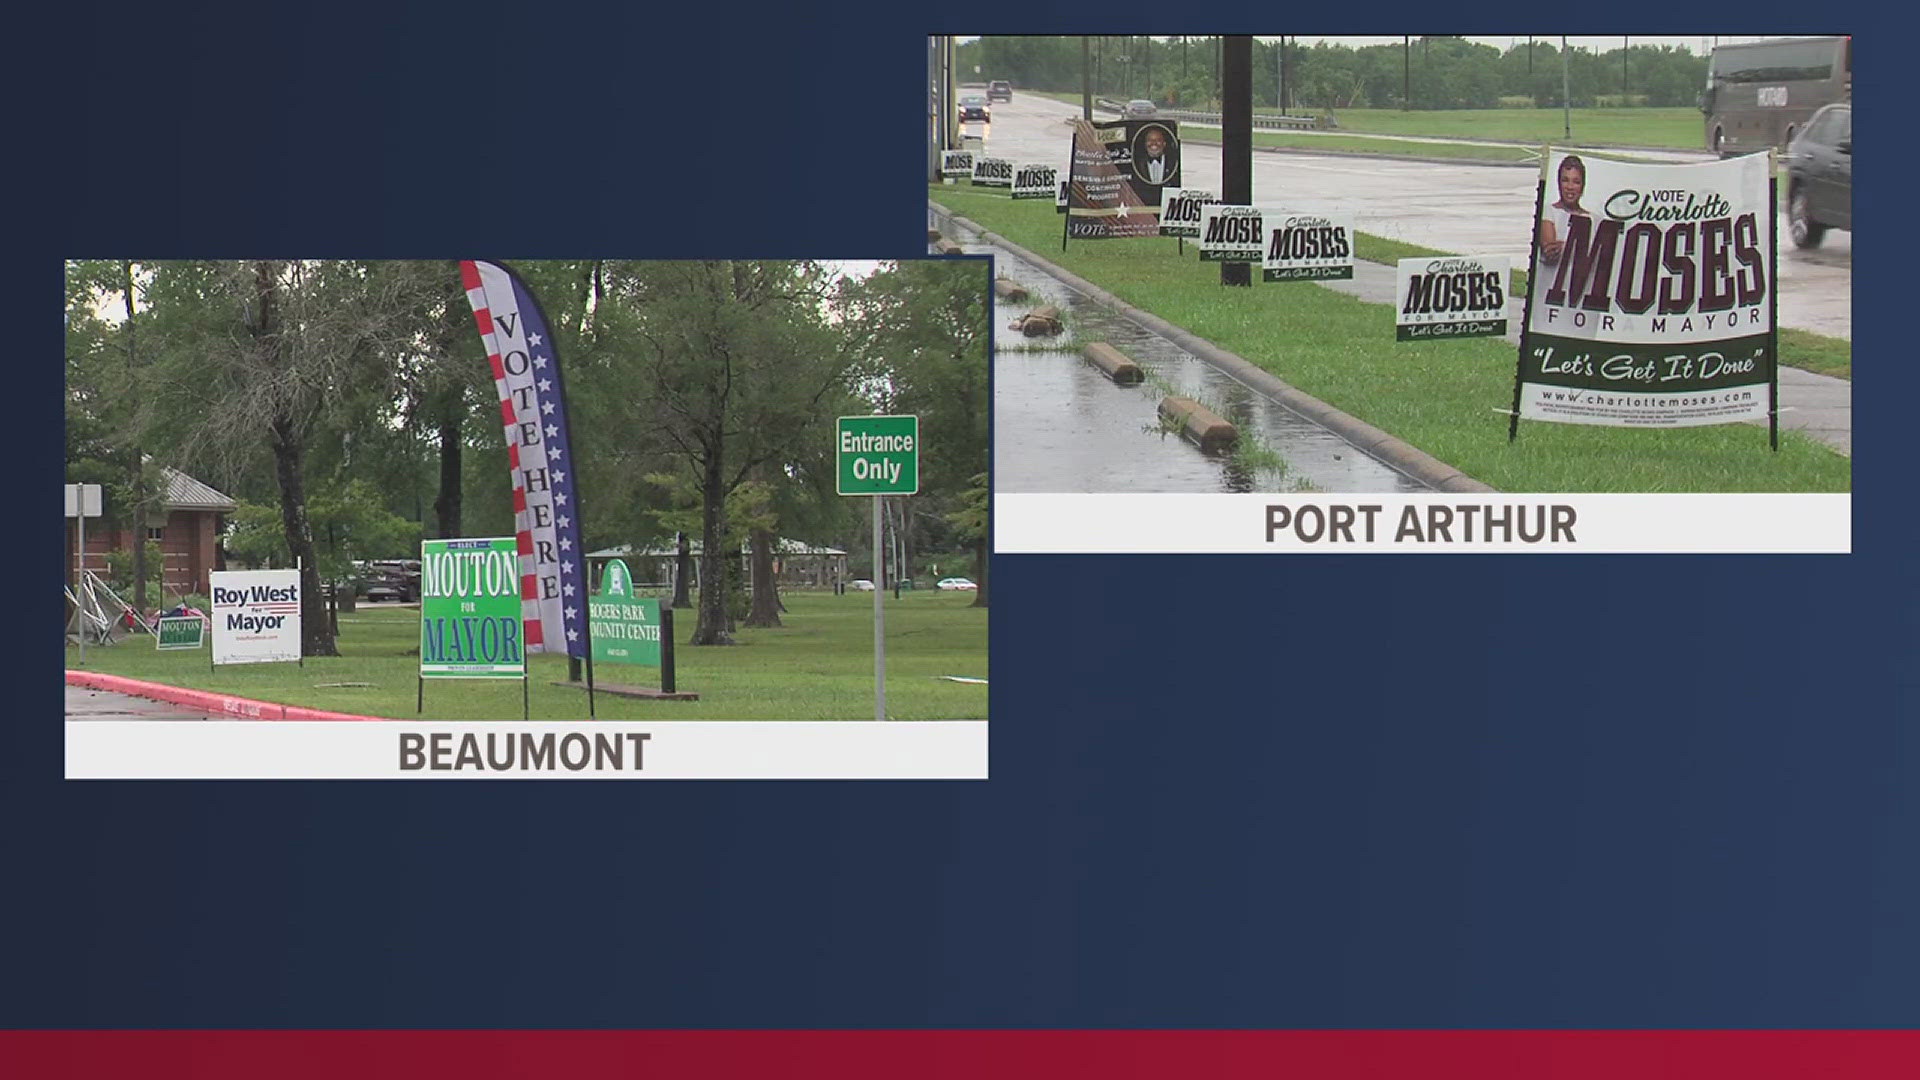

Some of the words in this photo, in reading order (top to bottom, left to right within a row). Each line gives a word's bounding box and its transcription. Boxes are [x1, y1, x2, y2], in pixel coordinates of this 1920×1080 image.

[944, 155, 973, 170] MOSE
[1014, 169, 1057, 188] MOSES
[1604, 189, 1732, 222] Charlotte
[1652, 189, 1685, 202] VOTE
[1074, 223, 1106, 235] VOTE
[1204, 216, 1263, 244] MOSE
[1267, 226, 1350, 261] MOSES
[1426, 260, 1484, 274] Charlotte
[1545, 212, 1766, 316] MOSES
[1402, 271, 1504, 315] MOSES
[1448, 312, 1500, 320] MAYOR
[1548, 308, 1615, 331] FOR
[1652, 308, 1760, 333] MAYOR
[1600, 354, 1656, 382] Get
[1660, 354, 1695, 382] It
[1542, 390, 1752, 407] www.charlottemoses.com
[841, 430, 914, 453] Entrance
[494, 312, 541, 448] VOTE
[523, 468, 560, 600] HERE
[853, 457, 902, 484] Only
[424, 550, 519, 598] MOUTON
[214, 587, 249, 607] Roy
[250, 585, 297, 602] West
[461, 601, 476, 612] FOR
[227, 613, 285, 633] Mayor
[622, 605, 646, 621] PARK
[161, 621, 200, 632] MOUTON
[423, 616, 520, 663] MAYOR
